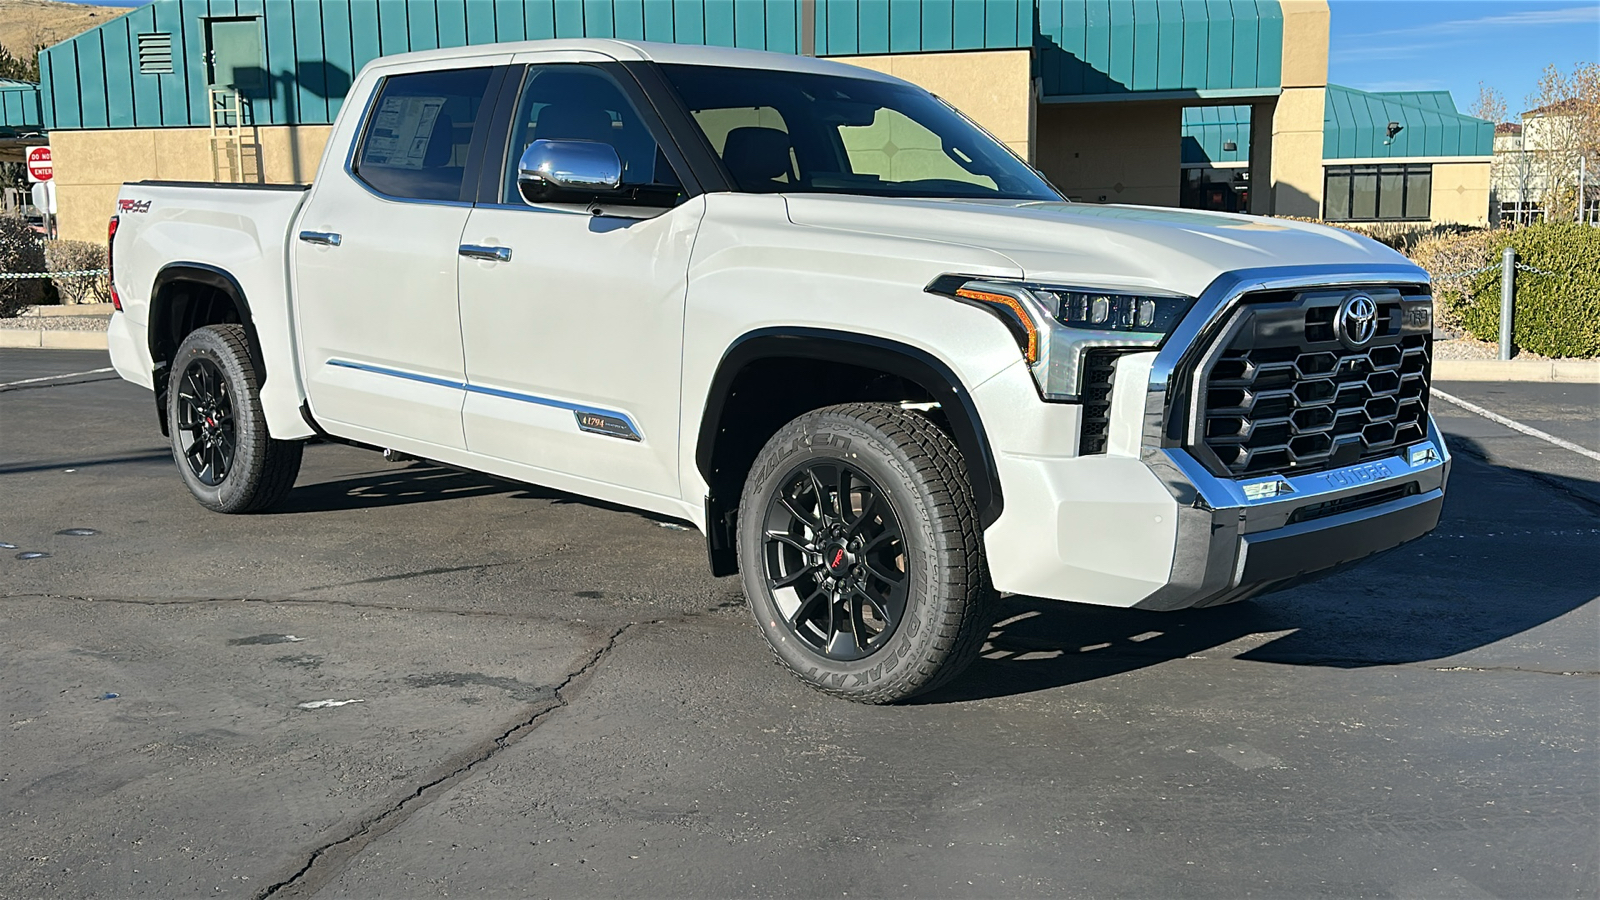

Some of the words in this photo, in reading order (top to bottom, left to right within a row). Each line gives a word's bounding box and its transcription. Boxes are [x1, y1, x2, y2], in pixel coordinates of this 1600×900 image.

[118, 199, 135, 214] TRD
[1407, 308, 1428, 326] TRD
[1316, 463, 1394, 488] TUNDRA
